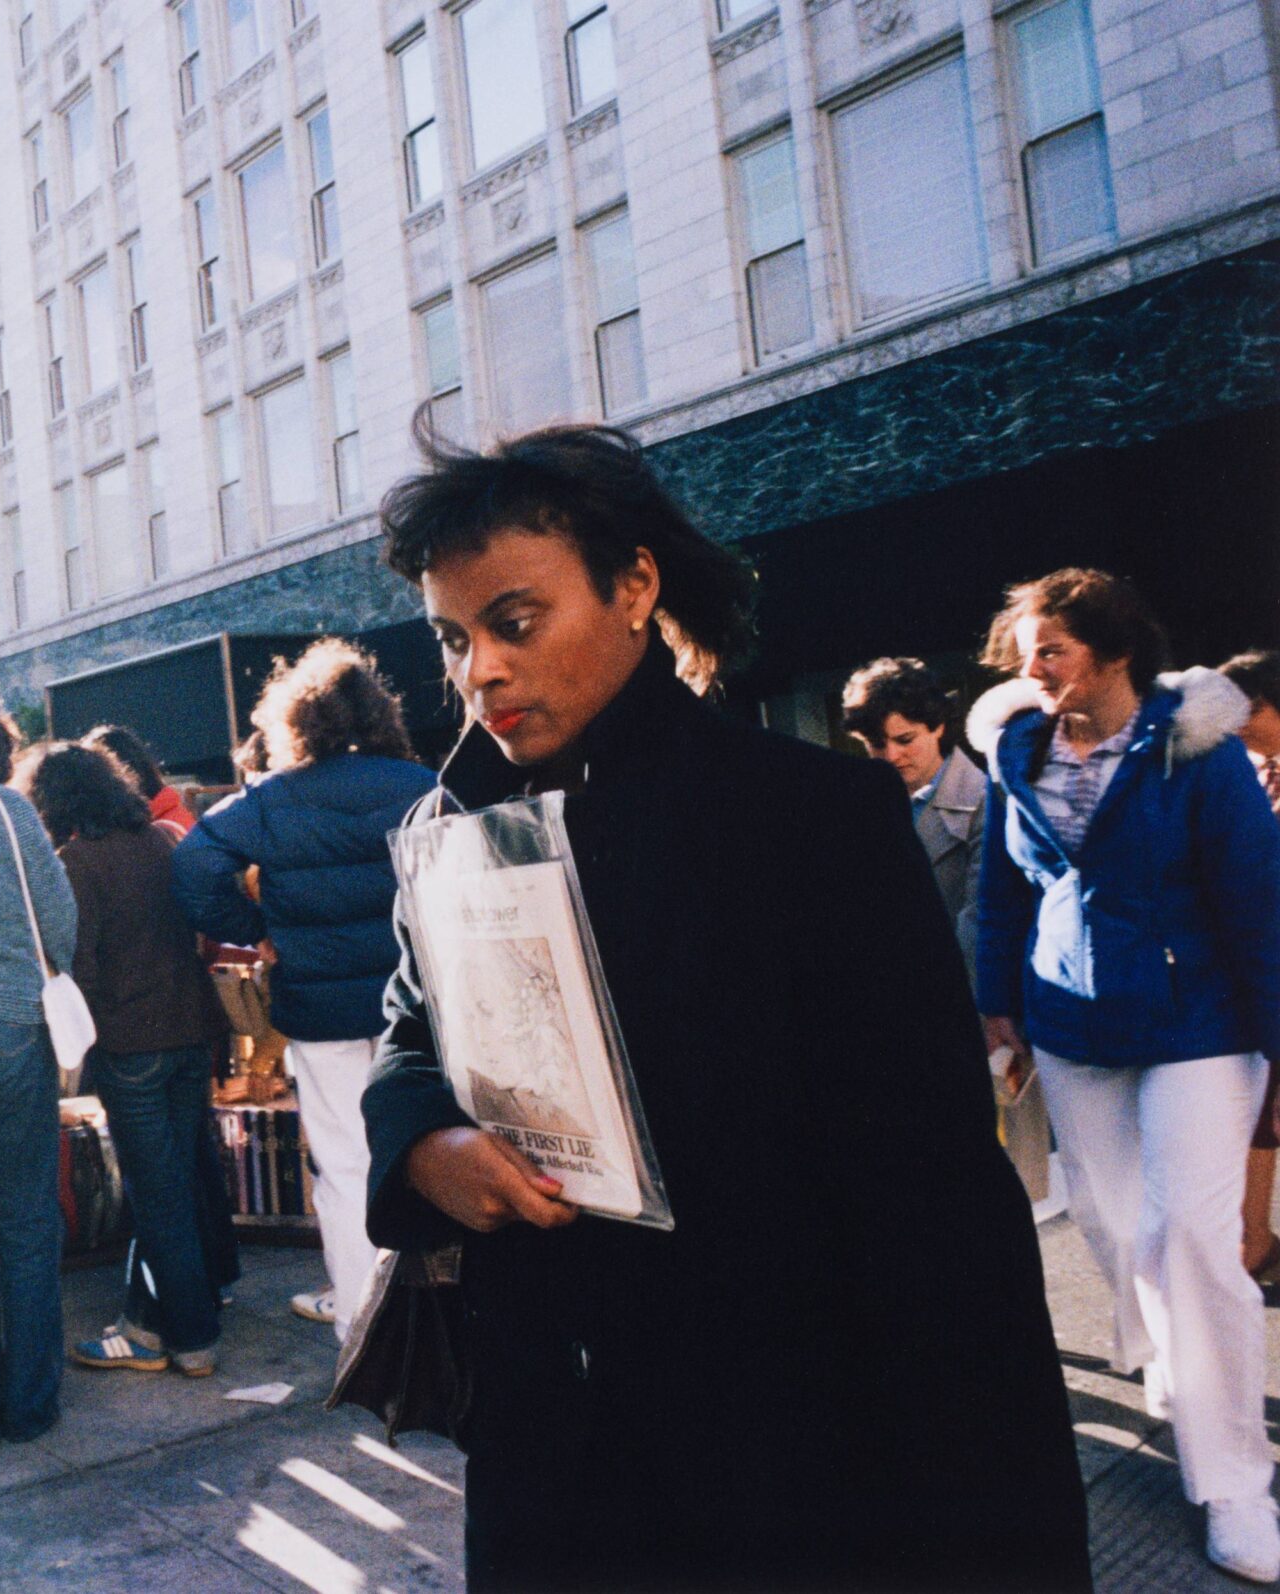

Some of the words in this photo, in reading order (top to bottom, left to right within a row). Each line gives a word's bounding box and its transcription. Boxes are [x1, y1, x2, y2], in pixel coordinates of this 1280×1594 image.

[492, 1125, 523, 1147] THE
[524, 1130, 565, 1153] FIRST
[567, 1138, 595, 1159] LIE
